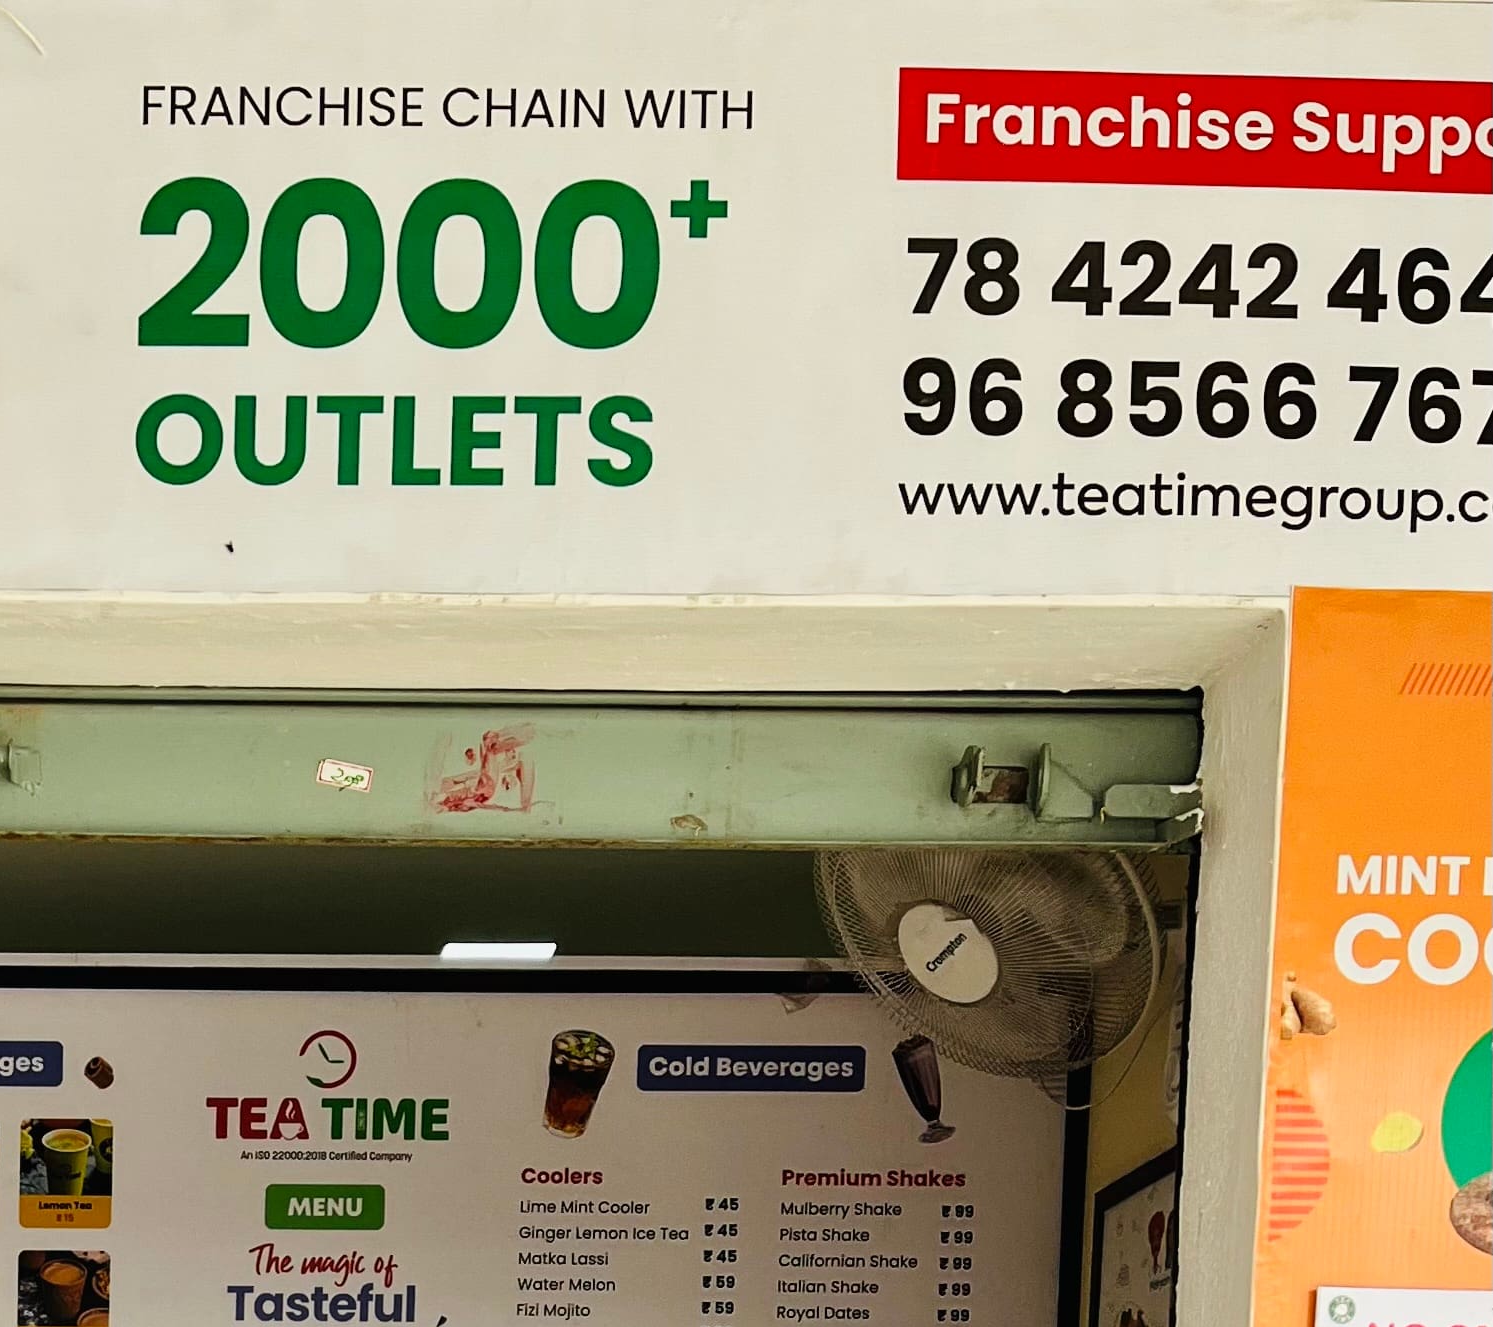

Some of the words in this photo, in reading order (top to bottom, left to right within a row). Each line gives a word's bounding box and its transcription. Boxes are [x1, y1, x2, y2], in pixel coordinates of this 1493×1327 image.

[142, 86, 423, 127] FRANCHISE
[443, 87, 605, 128] CHAIN
[625, 90, 753, 129] WITH
[926, 93, 1273, 150] Franchise
[138, 177, 728, 349] 2000+
[908, 237, 1020, 316] 78
[1052, 240, 1298, 319] 4242
[903, 357, 1022, 436] 96
[1058, 359, 1316, 440] 8566
[135, 394, 653, 487] OUTLETS
[899, 473, 1493, 533] www.teatimegroup.c
[1337, 855, 1470, 896] MINT
[926, 933, 968, 972] Crompton
[649, 1057, 708, 1076] Cold
[716, 1058, 854, 1082] Beverages
[206, 1098, 309, 1140] TEA
[322, 1098, 449, 1140] TIME
[521, 1168, 603, 1184] Coolers
[782, 1168, 881, 1186] Premium
[887, 1170, 966, 1187] Shakes
[288, 1198, 362, 1217] MENU
[520, 1201, 556, 1214] Lime
[561, 1201, 594, 1214] Mint
[599, 1201, 650, 1214] Cooler
[781, 1203, 850, 1218] Mulberry
[854, 1203, 902, 1216] Shake
[519, 1227, 572, 1242] Ginger
[576, 1227, 628, 1240] Lemon
[633, 1227, 656, 1240] Ice
[661, 1228, 689, 1240] Tea
[249, 1243, 293, 1275] The
[301, 1252, 365, 1287] magic
[375, 1255, 398, 1288] of
[518, 1252, 566, 1265] Matka
[572, 1252, 608, 1265] Lassi
[778, 1254, 865, 1268] Californian
[870, 1255, 917, 1268] Shake
[227, 1283, 416, 1322] Tasteful
